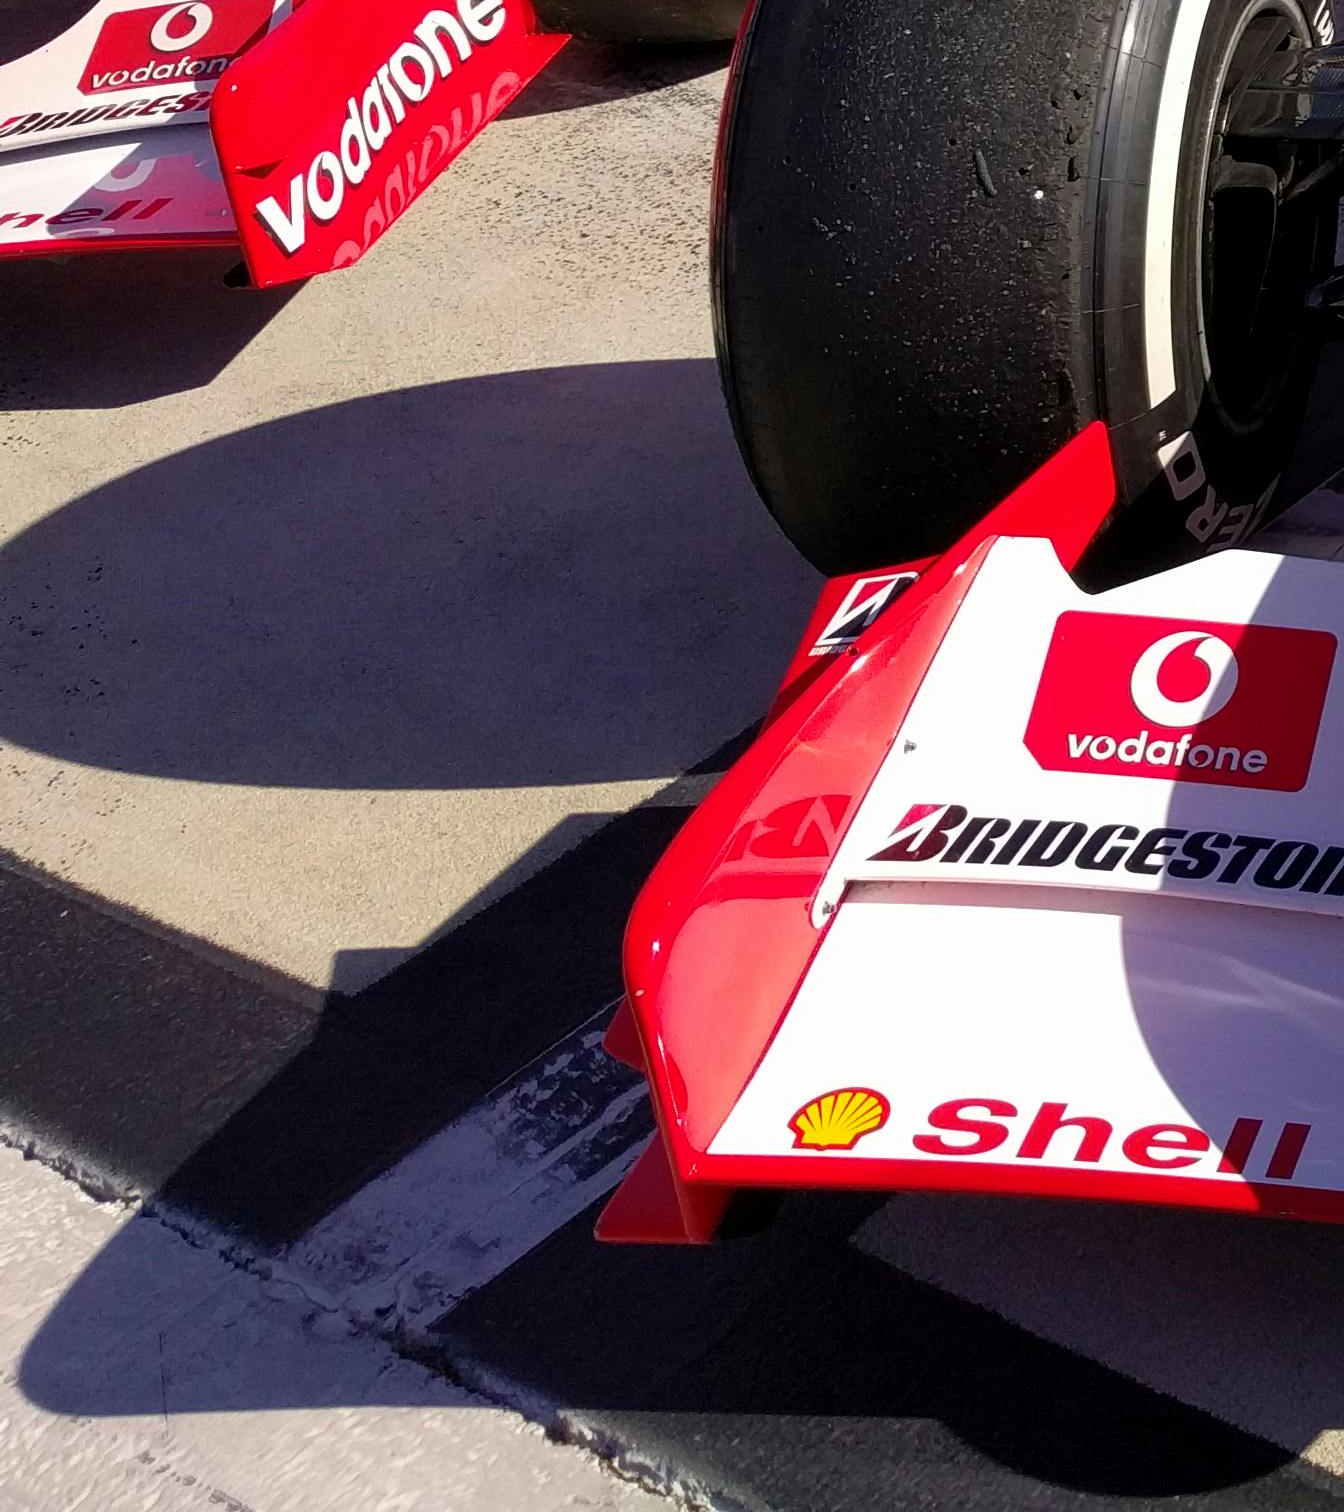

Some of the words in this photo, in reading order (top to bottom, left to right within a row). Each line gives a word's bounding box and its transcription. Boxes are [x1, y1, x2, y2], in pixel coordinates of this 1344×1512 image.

[91, 55, 231, 89] vodafon
[1066, 729, 1268, 774] vodafone
[912, 1097, 1311, 1180] Shell
